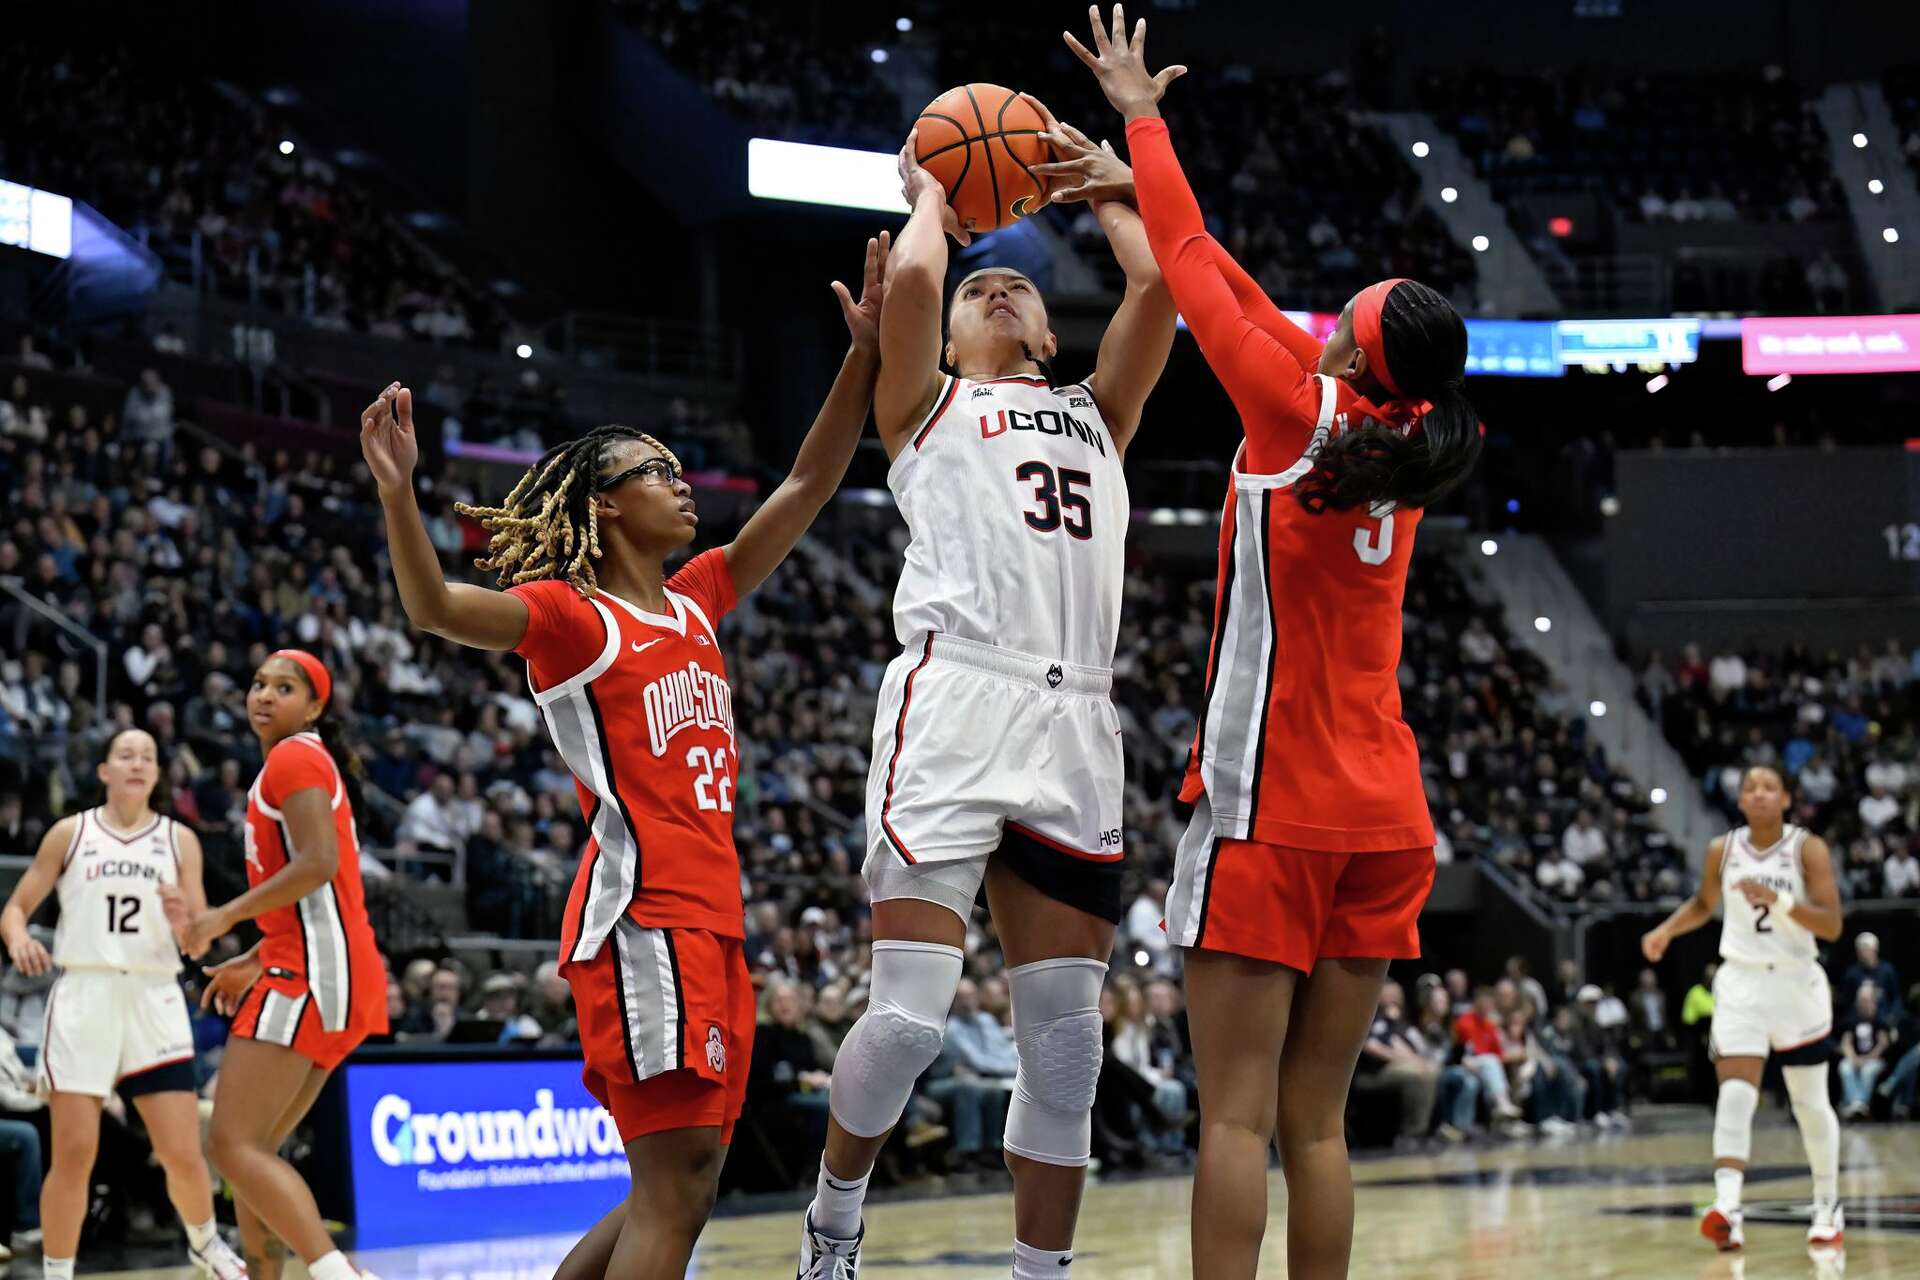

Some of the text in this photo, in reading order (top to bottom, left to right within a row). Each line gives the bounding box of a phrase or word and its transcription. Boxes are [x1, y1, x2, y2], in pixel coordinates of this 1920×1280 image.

[979, 408, 1107, 458] UCONN
[1015, 461, 1093, 541] 35
[686, 746, 733, 813] 22
[1099, 829, 1123, 847] HIS
[105, 893, 142, 934] 12
[1753, 903, 1773, 933] 2
